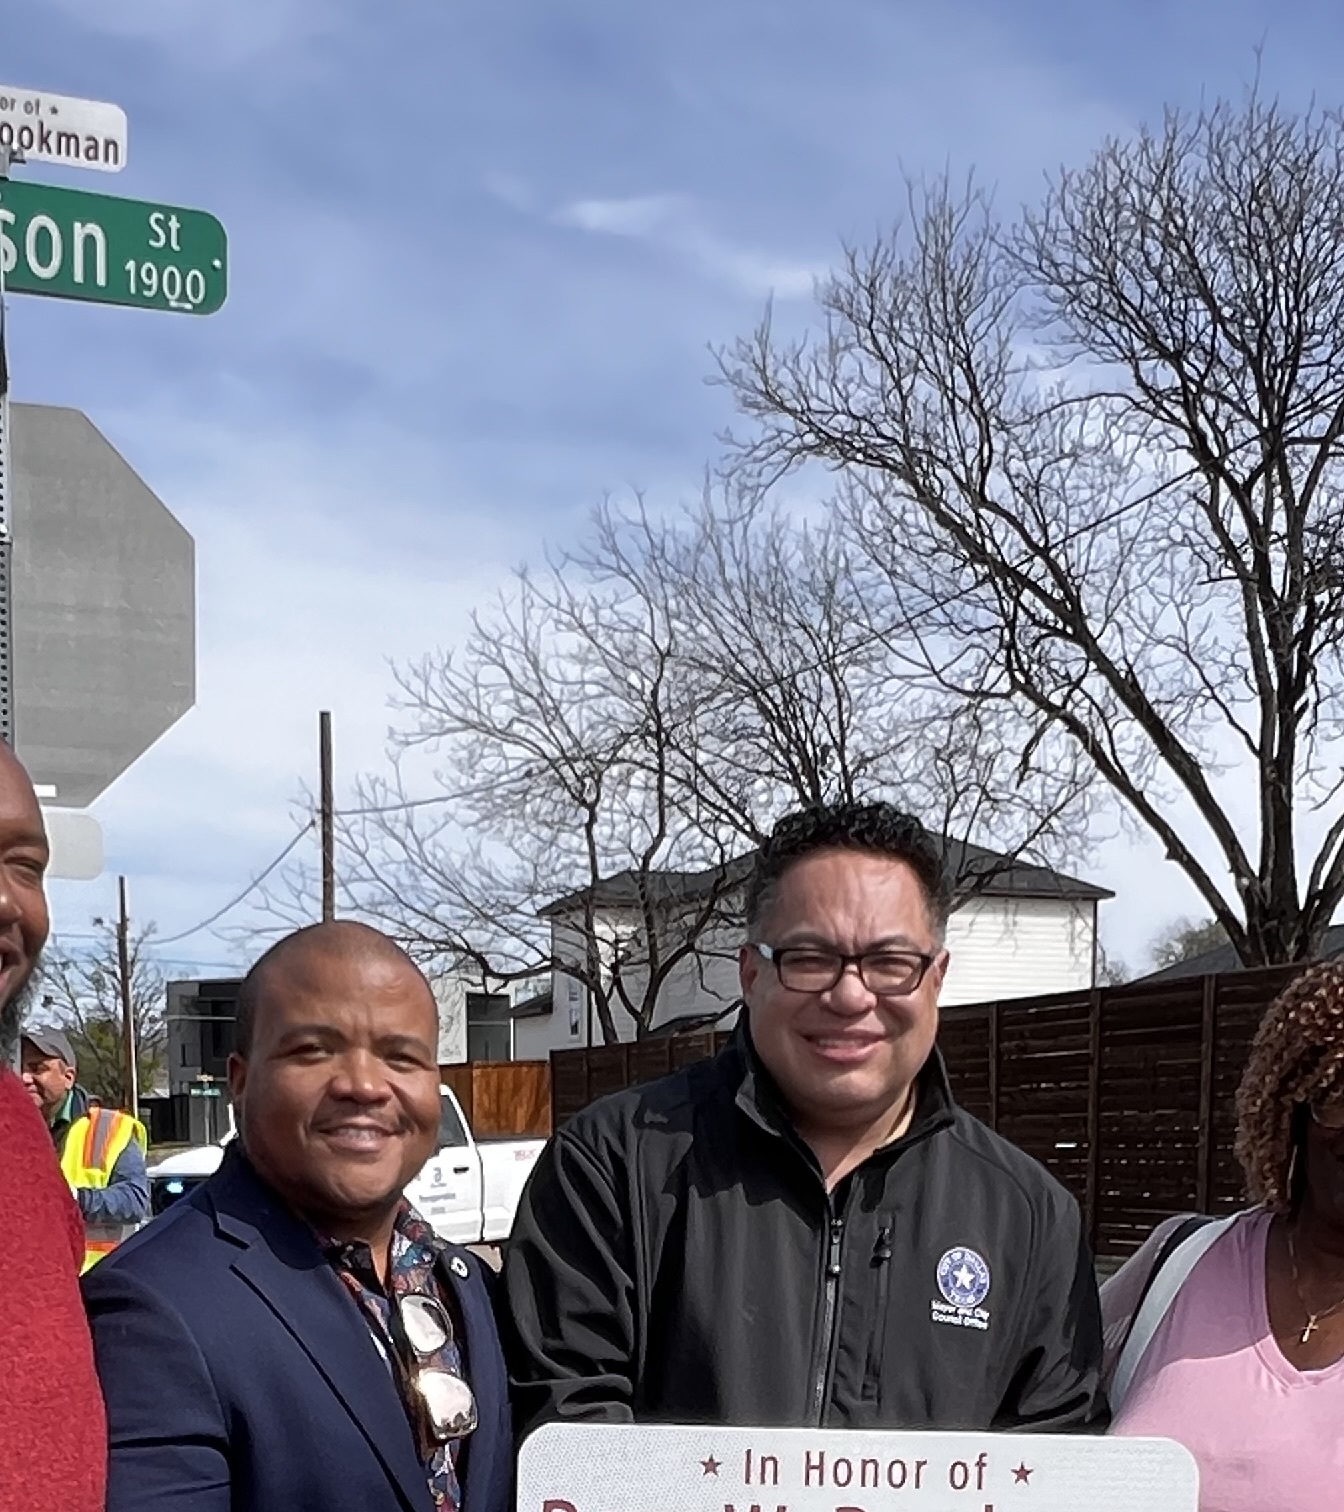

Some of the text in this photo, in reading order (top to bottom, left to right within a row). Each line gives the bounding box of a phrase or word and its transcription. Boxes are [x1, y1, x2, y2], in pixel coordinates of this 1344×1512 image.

[22, 98, 41, 116] of
[148, 212, 182, 252] St
[124, 258, 206, 306] 1900
[744, 1449, 988, 1491] In Honor of
